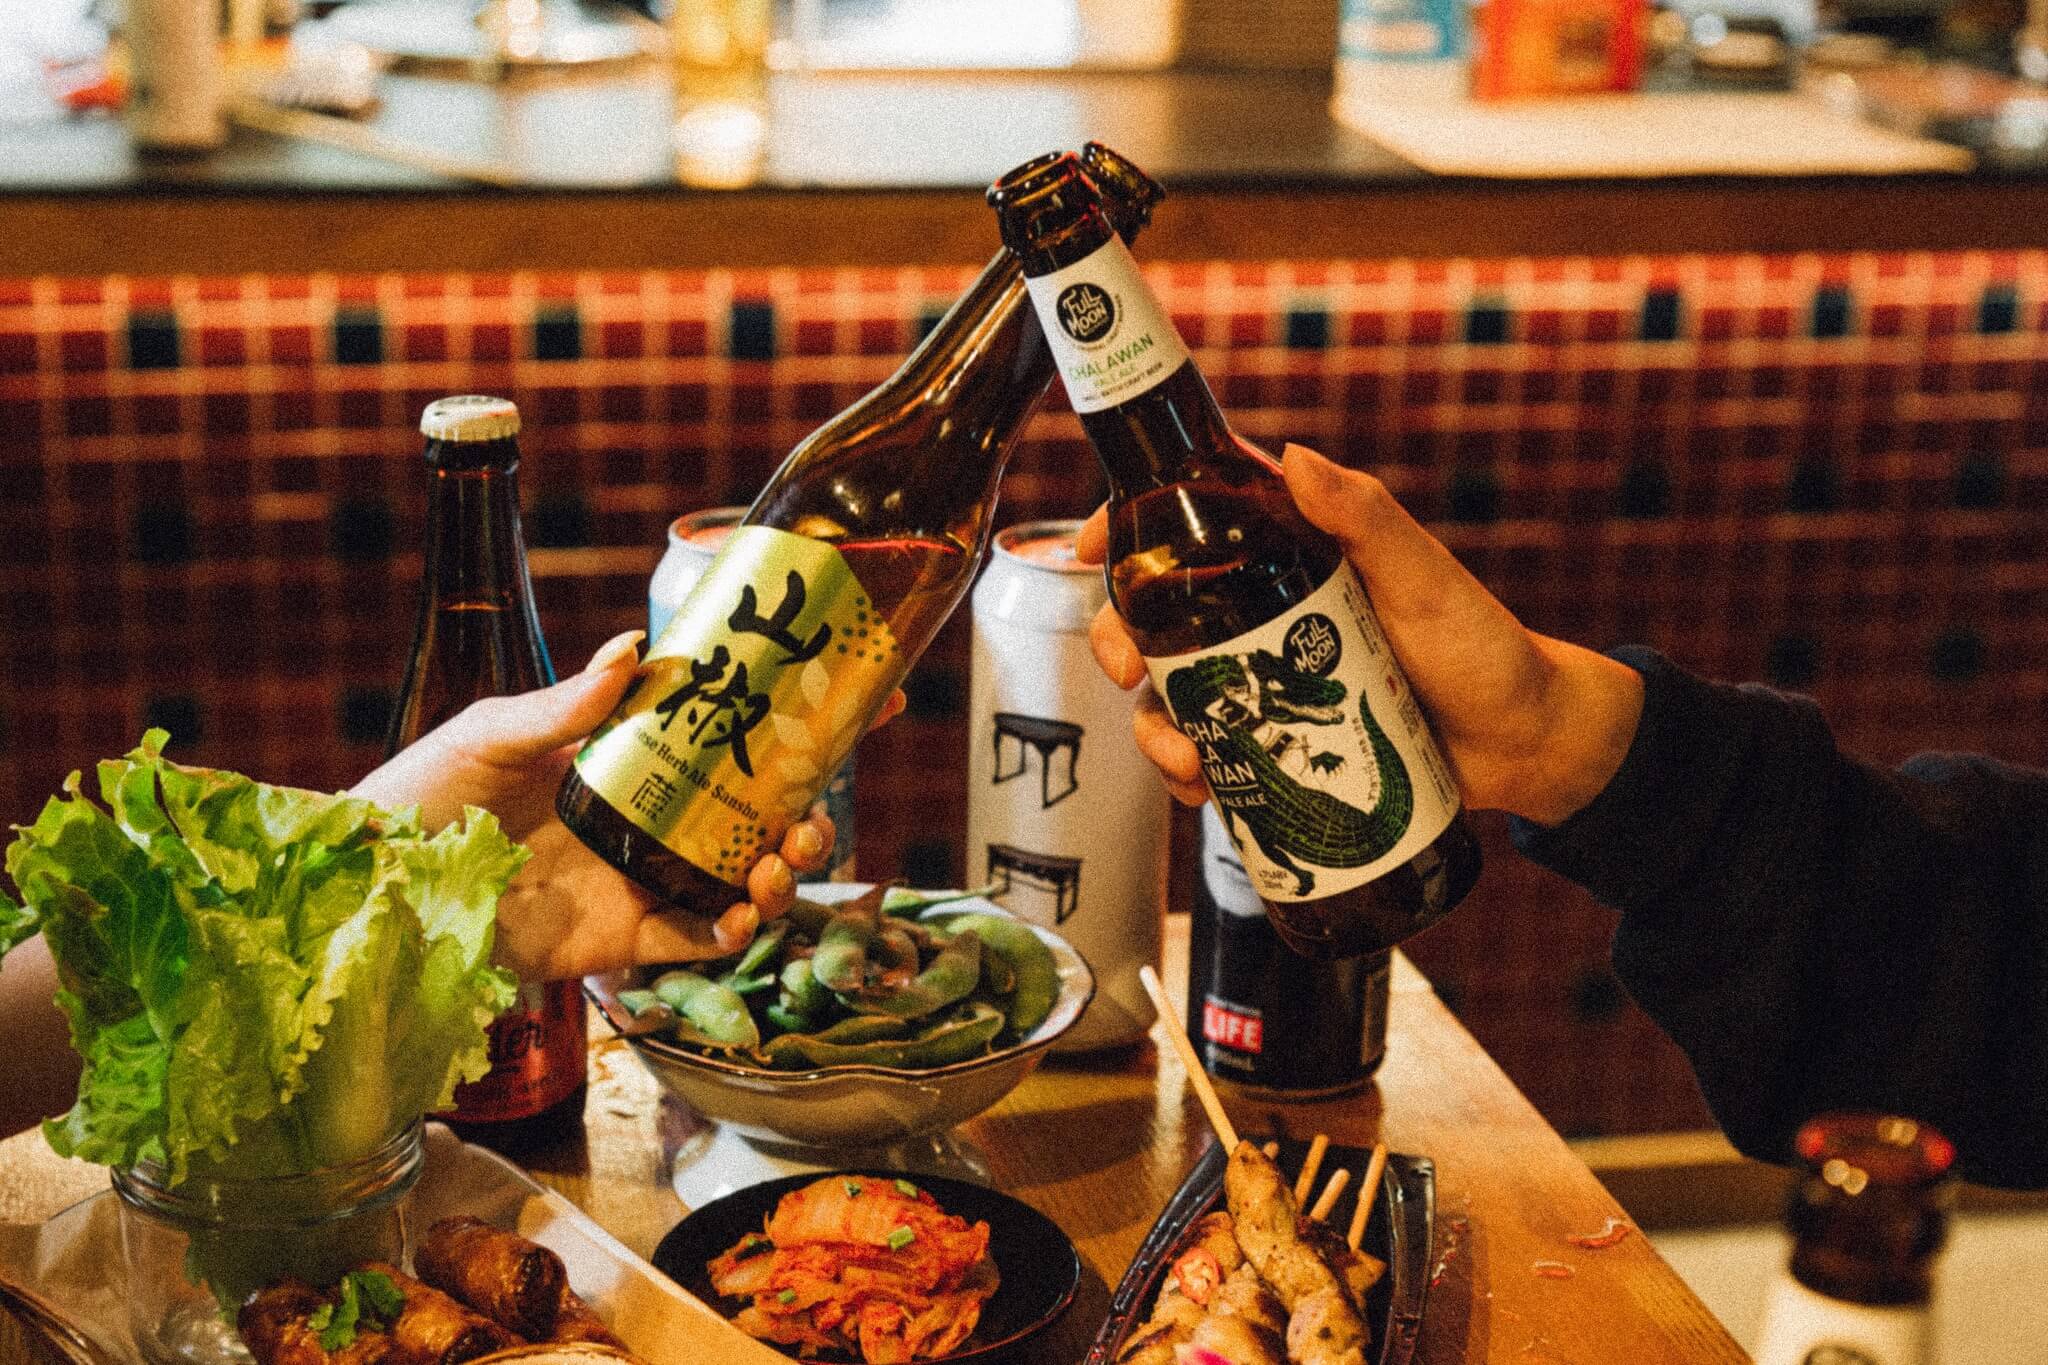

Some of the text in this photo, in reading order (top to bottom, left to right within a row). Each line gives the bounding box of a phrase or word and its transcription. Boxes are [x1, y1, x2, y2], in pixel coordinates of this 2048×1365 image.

[1068, 333, 1154, 381] CHALAWAN
[1184, 720, 1229, 743] CHA
[657, 743, 689, 776] Herb
[687, 767, 711, 790] Ale
[711, 783, 759, 821] Sansho
[1207, 760, 1256, 785] WAN
[1245, 792, 1267, 807] ALE
[1204, 1006, 1259, 1050] LIFE
